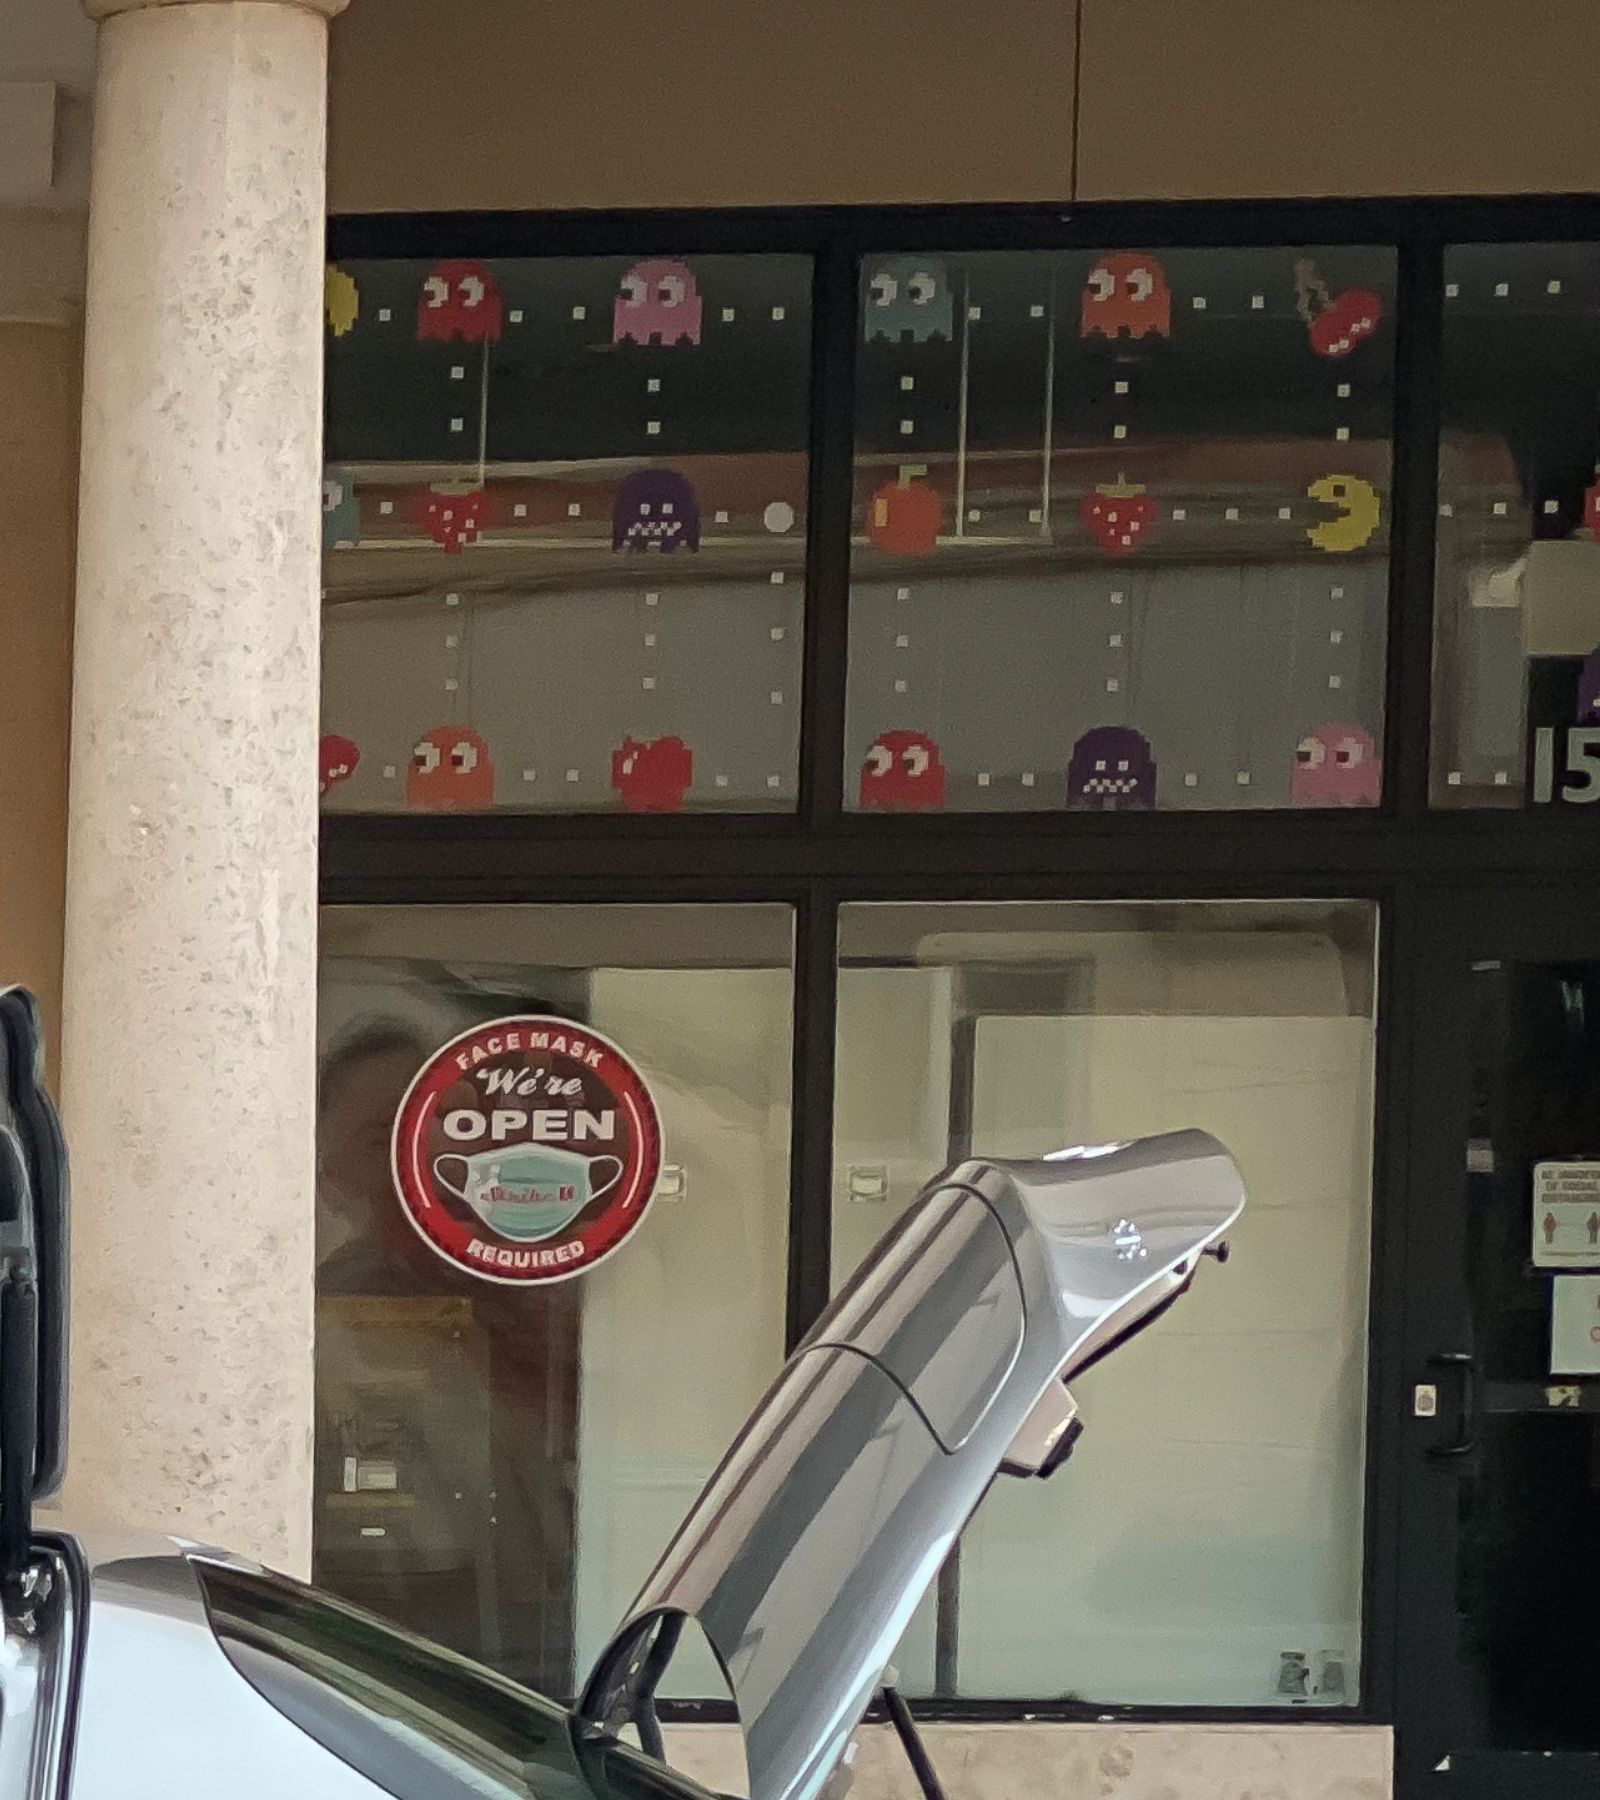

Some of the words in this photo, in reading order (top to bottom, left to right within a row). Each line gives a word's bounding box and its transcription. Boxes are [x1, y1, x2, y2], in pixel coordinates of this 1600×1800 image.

[454, 1032, 522, 1071] FACE
[529, 1032, 604, 1069] MASK
[475, 1066, 583, 1097] We're
[442, 1108, 616, 1142] OPEN
[465, 1239, 586, 1269] REQUIRED
